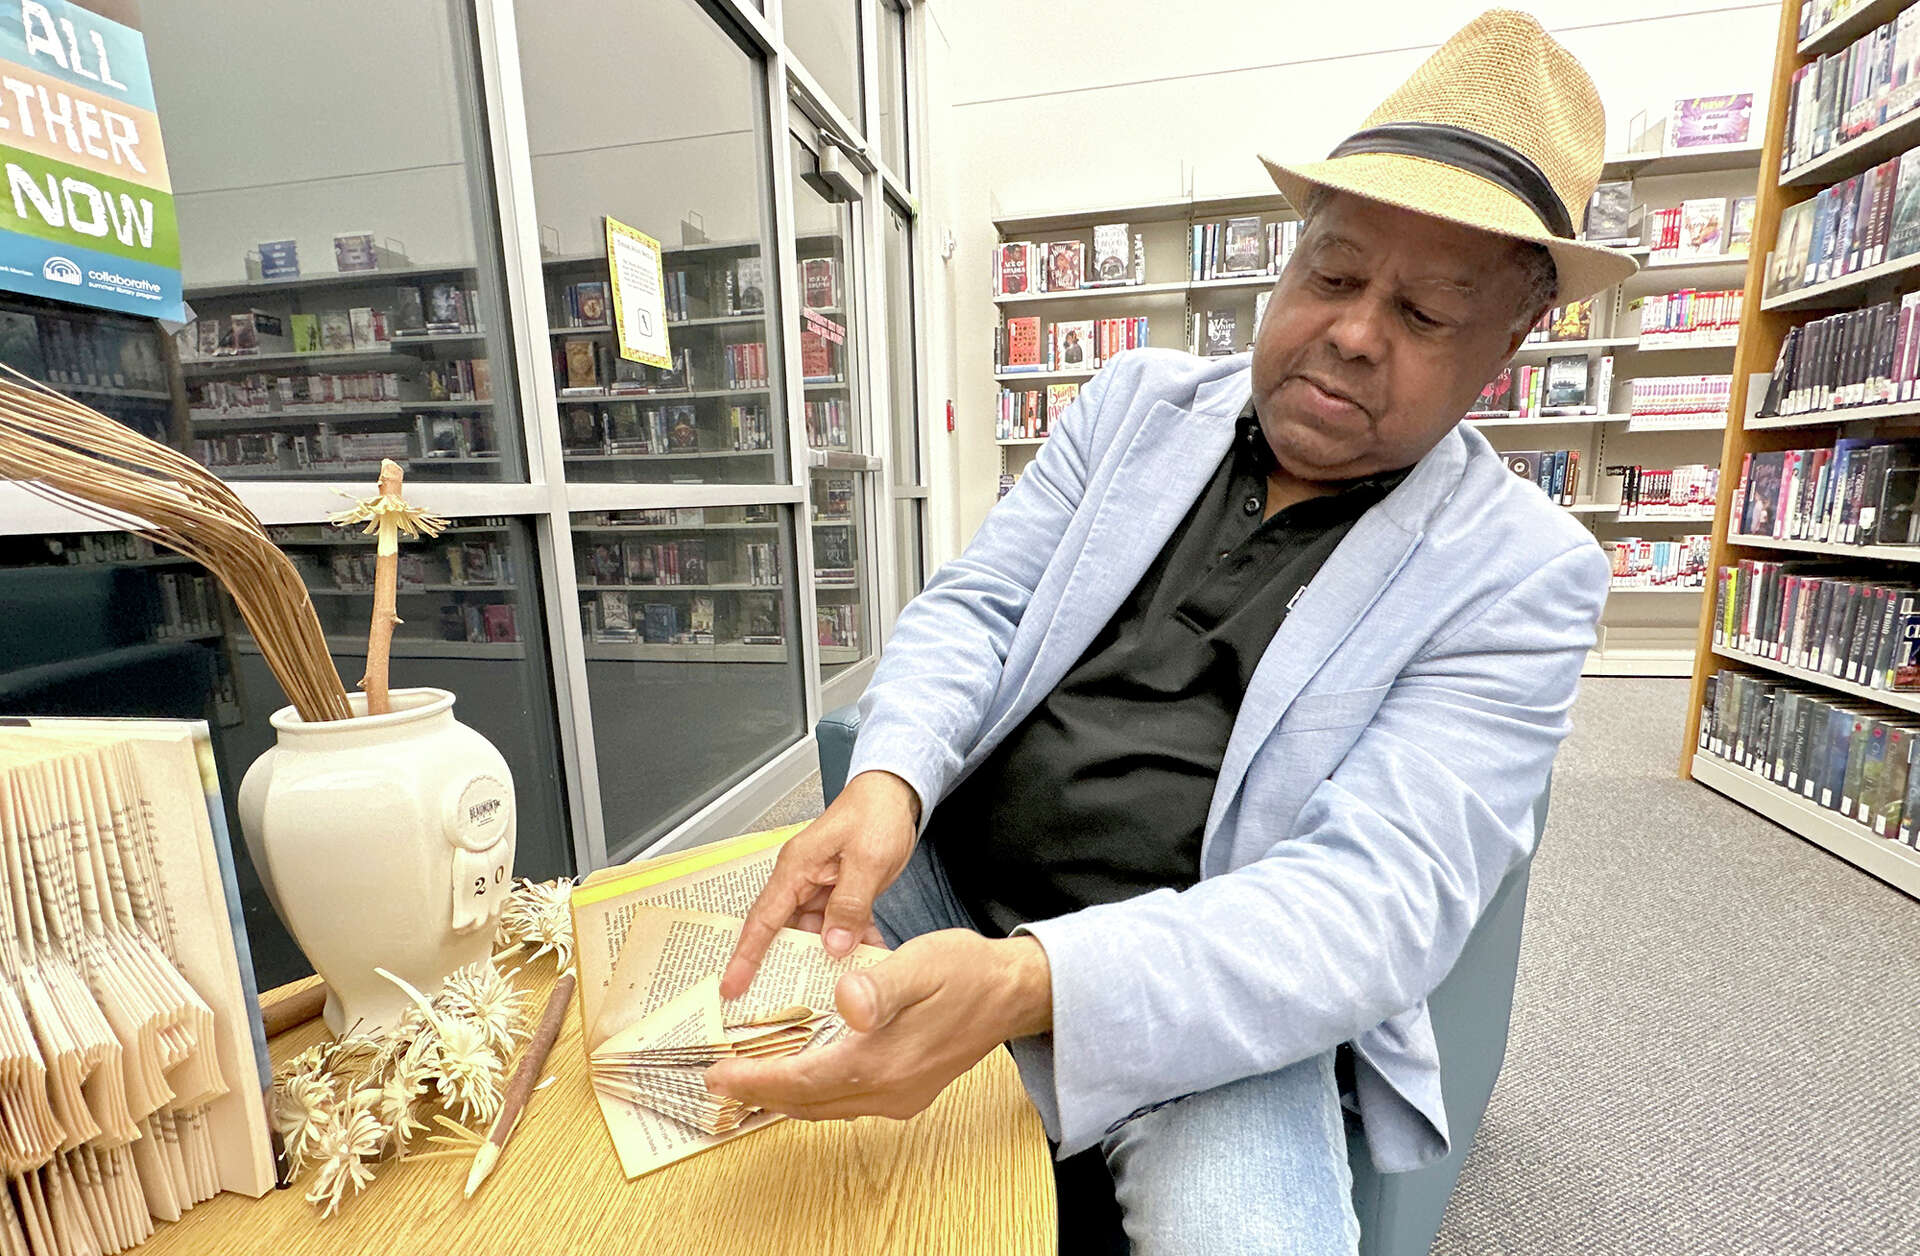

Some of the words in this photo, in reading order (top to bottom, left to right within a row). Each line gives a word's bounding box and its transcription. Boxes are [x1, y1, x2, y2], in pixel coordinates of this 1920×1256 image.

[21, 0, 128, 91] ALL
[5, 163, 153, 249] NOW
[88, 270, 161, 293] collaborative
